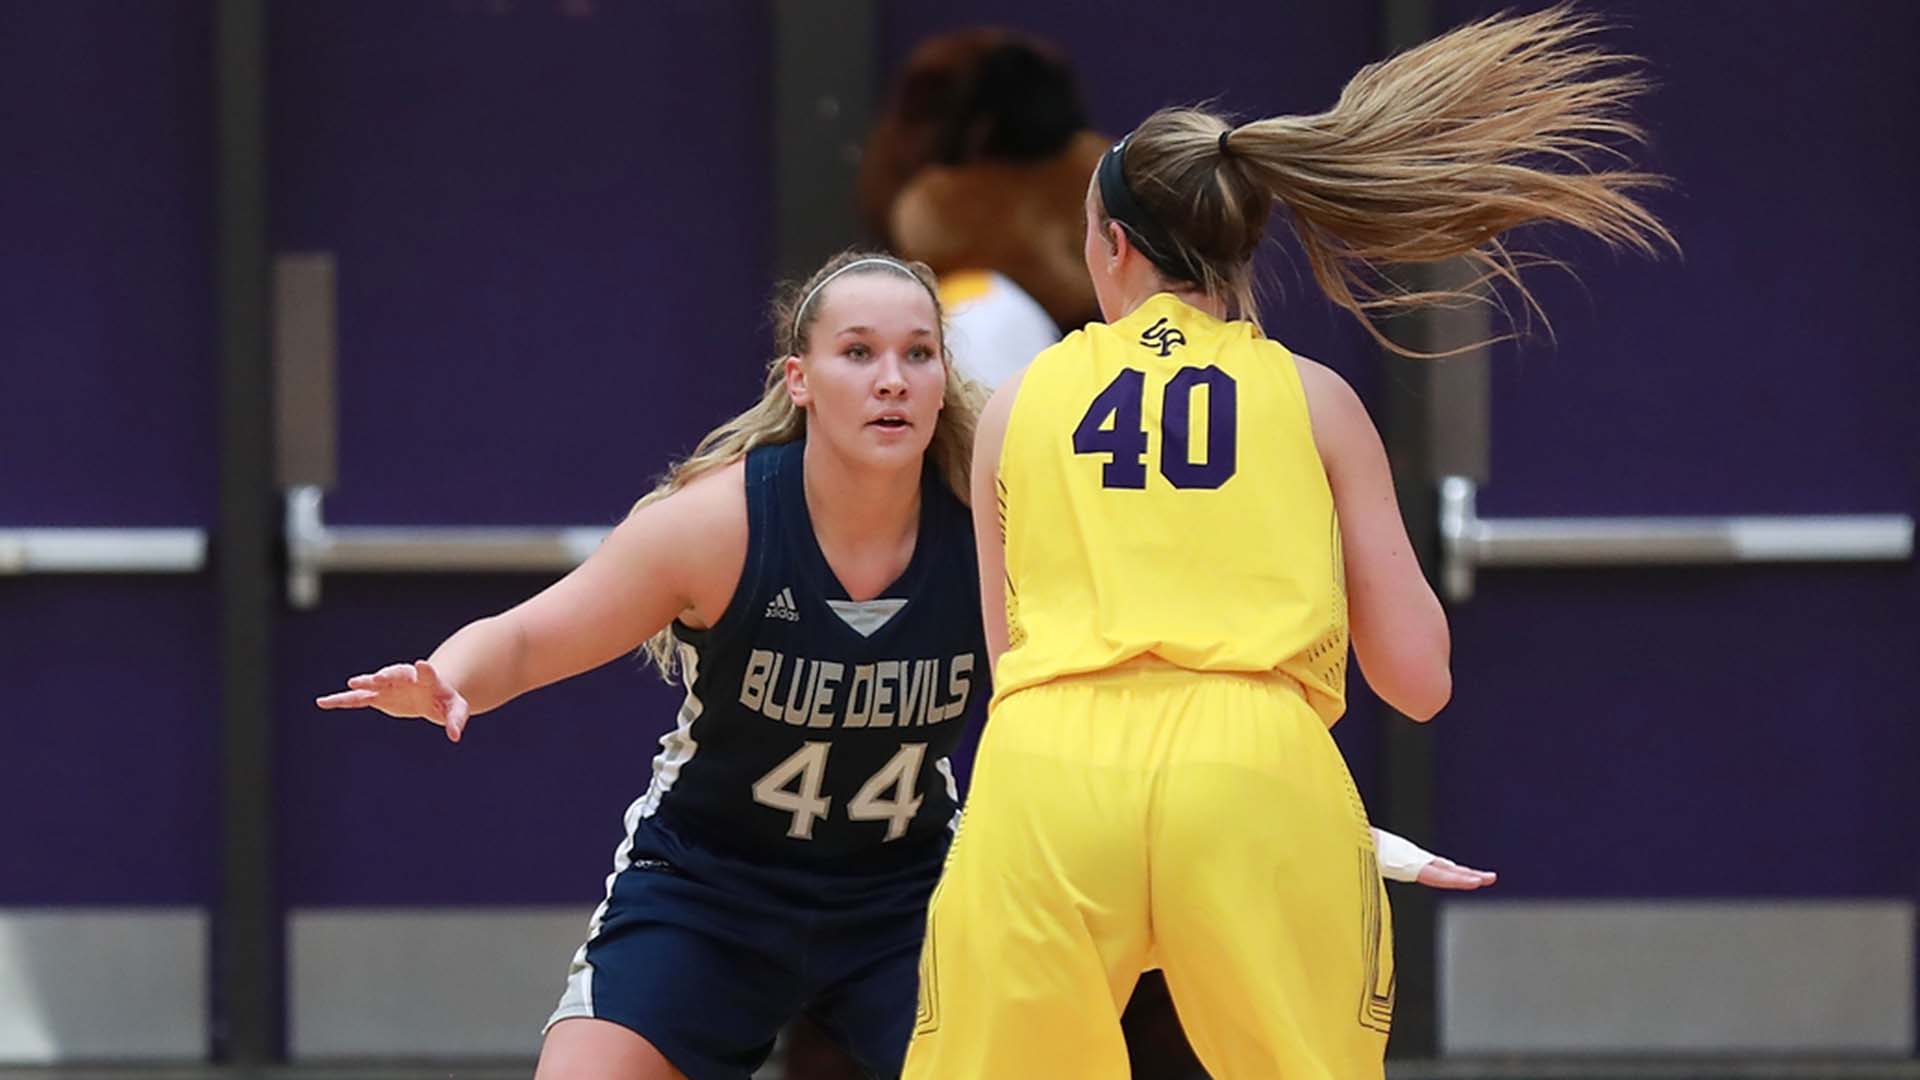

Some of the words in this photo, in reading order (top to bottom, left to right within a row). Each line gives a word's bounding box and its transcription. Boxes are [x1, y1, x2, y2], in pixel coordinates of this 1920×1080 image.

[1072, 364, 1237, 490] 40
[765, 607, 800, 622] adidas
[739, 648, 845, 729] BLUE
[841, 652, 975, 729] DEVILS
[751, 740, 929, 843] 44
